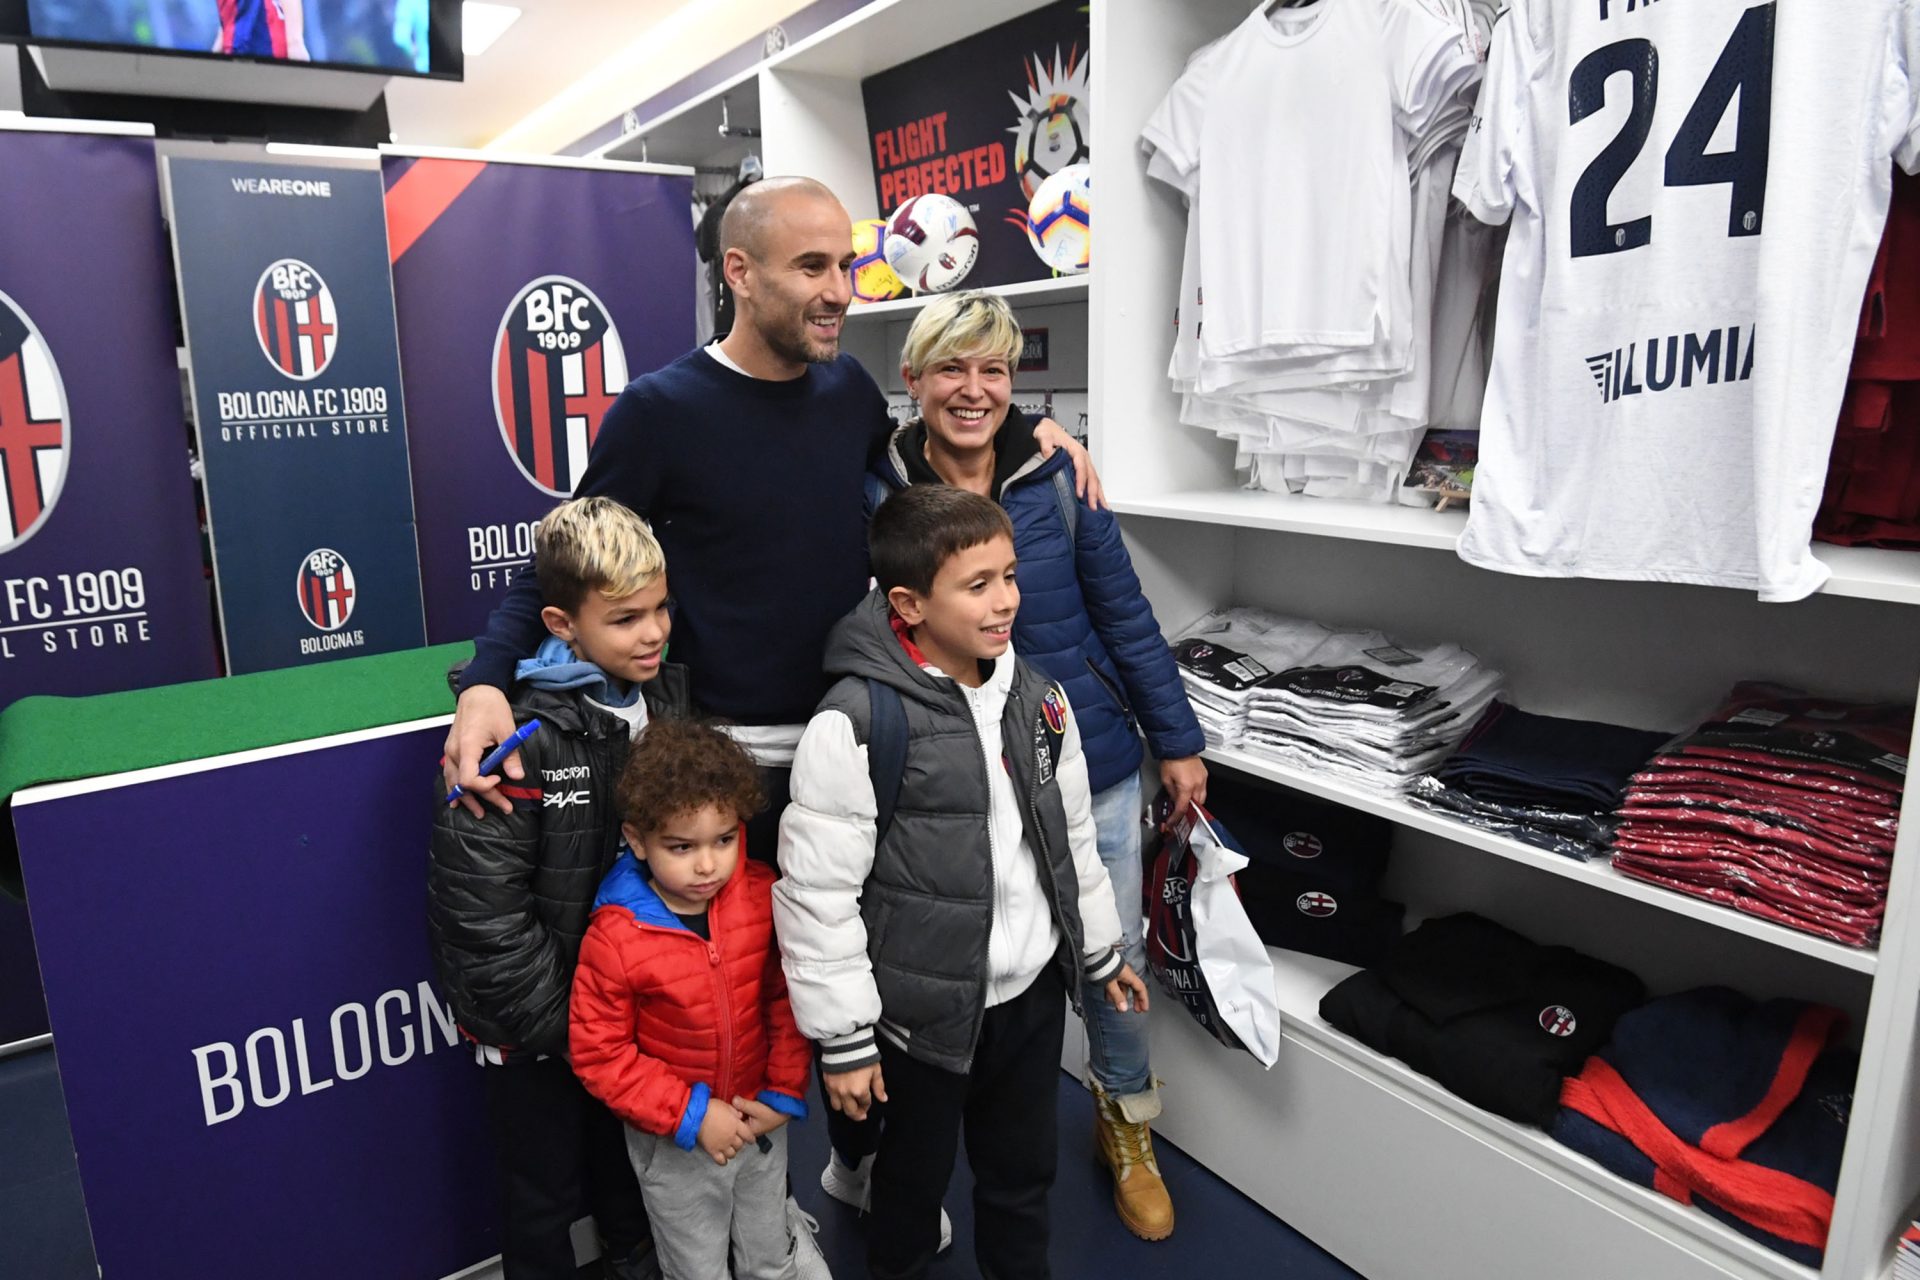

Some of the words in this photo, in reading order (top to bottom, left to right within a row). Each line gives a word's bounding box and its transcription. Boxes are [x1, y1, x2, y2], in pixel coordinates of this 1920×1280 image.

[875, 112, 948, 169] FLIGHT
[1568, 0, 1777, 258] 24
[232, 177, 331, 198] WEAREONE
[880, 142, 1007, 210] PERFECTED
[272, 264, 312, 291] BFC
[280, 288, 307, 301] 1909
[525, 284, 591, 332] BFC
[537, 331, 582, 350] 1909
[218, 389, 311, 420] BOLOGNA
[313, 388, 338, 416] FC
[341, 386, 388, 414] 1909
[221, 422, 318, 442] OFFICIAL
[332, 419, 389, 436] STORE
[468, 521, 541, 562] BOLO
[309, 551, 338, 571] BFC
[4, 577, 52, 621] FC
[57, 567, 146, 615] 1909
[43, 620, 151, 653] STORE
[300, 632, 354, 655] BOLOGNA
[541, 766, 590, 782] macron
[191, 980, 459, 1127] BOLOGN
